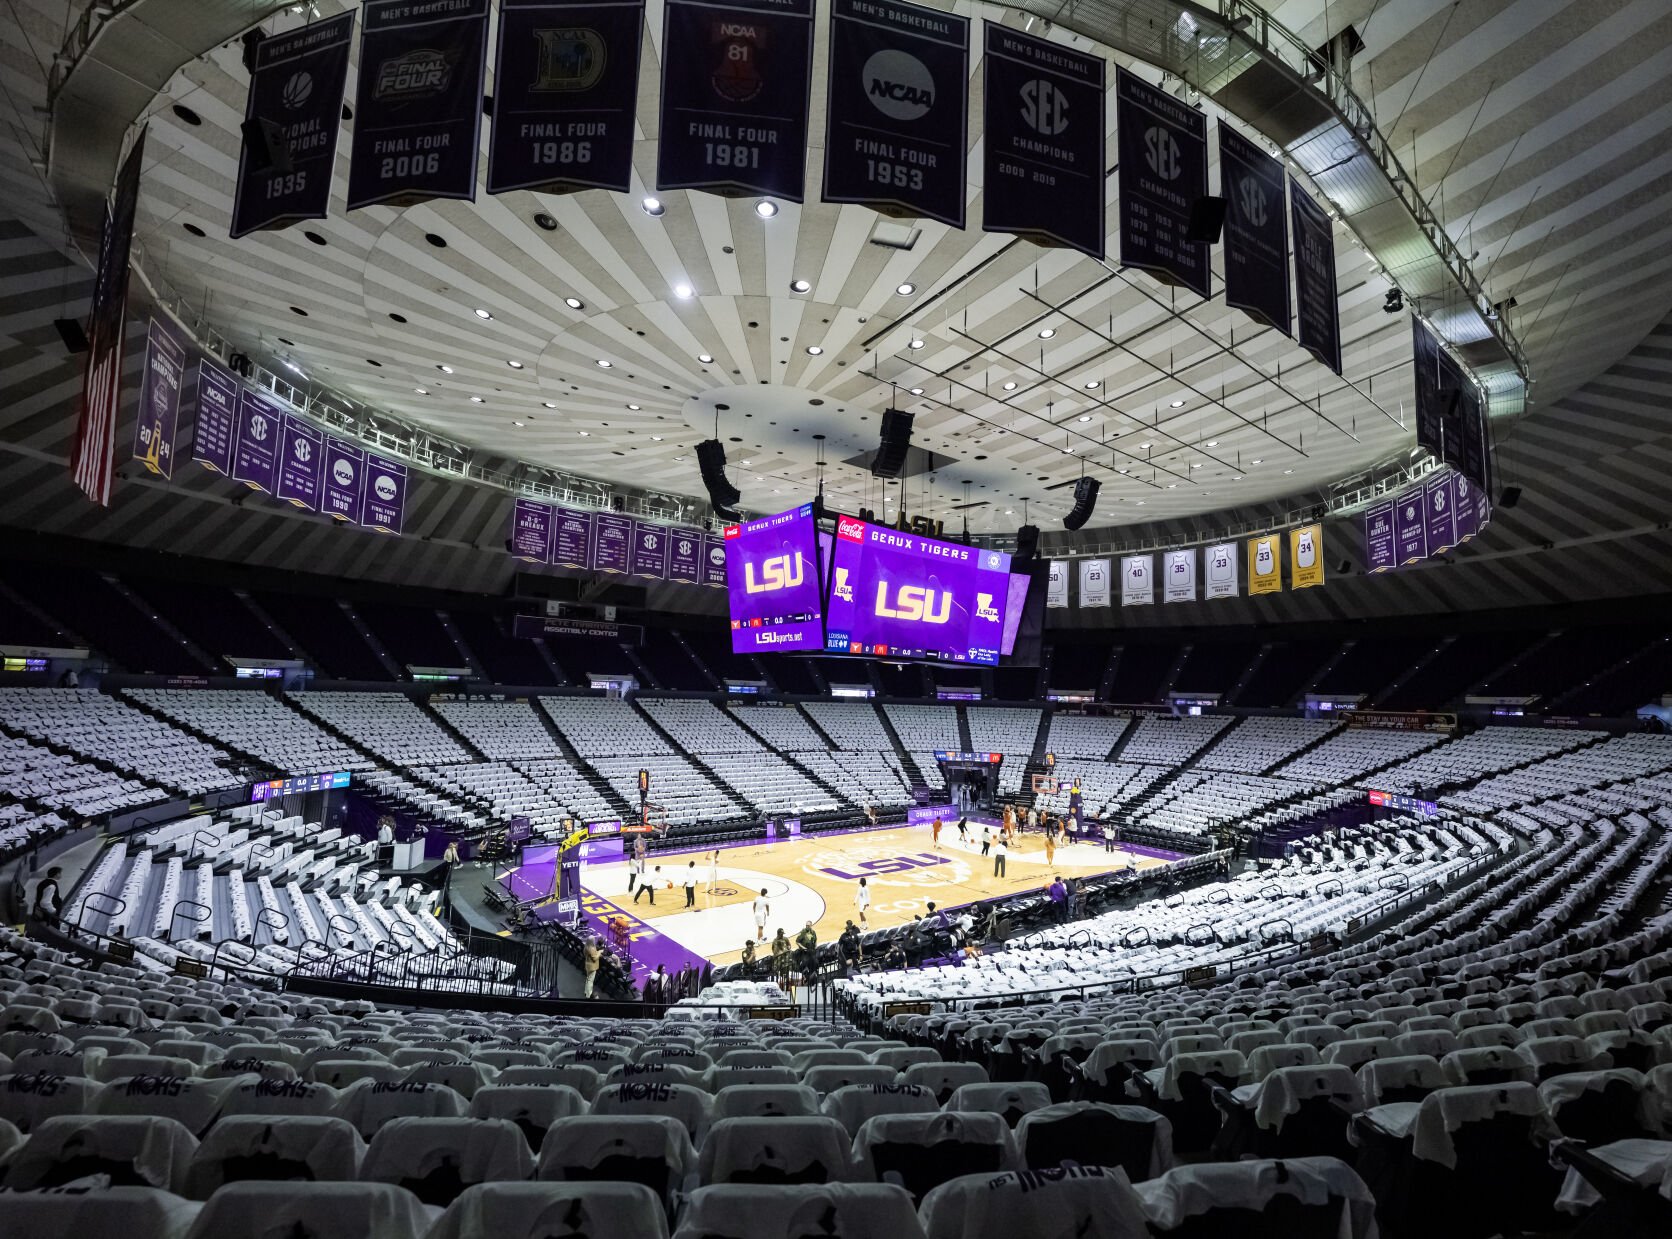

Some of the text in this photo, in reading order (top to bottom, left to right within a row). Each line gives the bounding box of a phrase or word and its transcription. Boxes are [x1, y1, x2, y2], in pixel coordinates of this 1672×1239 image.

[380, 0, 471, 20] MEN'S BASKETBALL
[852, 2, 950, 34] MEN'S BASKETBALL
[720, 23, 757, 39] NCAA
[728, 44, 748, 62] 81
[1003, 38, 1089, 75] MEN'S BASKETBALL
[398, 60, 444, 76] FINAL
[380, 71, 443, 93] FOUR
[869, 78, 932, 108] NCAA
[1019, 79, 1070, 136] SEC
[520, 122, 607, 138] FINAL FOUR
[689, 122, 777, 144] FINAL FOUR
[374, 133, 451, 154] FINAL FOUR
[532, 141, 592, 164] 1986
[855, 138, 937, 168] FINAL FOUR
[1013, 136, 1075, 163] CHAMPIONS
[1144, 126, 1182, 181] SEC
[380, 152, 440, 179] 2006
[705, 143, 759, 169] 1981
[867, 160, 923, 191] 1953
[999, 163, 1056, 186] 2009 2019
[266, 171, 307, 199] 1935
[1140, 177, 1187, 208] CHAMPIONS
[1239, 175, 1267, 227] SEC
[207, 386, 226, 405] NCAA
[250, 415, 268, 441] SEC
[140, 424, 170, 459] 20 24
[294, 438, 311, 462] SEC
[336, 469, 353, 482] NCAA
[330, 490, 352, 503] FINAL FOUR
[377, 485, 396, 496] NCAA
[333, 498, 349, 511] 1990
[371, 505, 396, 517] FINAL FOUR
[375, 513, 391, 524] 1991
[520, 520, 545, 530] BREAUX
[748, 514, 793, 532] GEAUX TIGERS
[643, 534, 658, 550] SEC
[678, 540, 692, 556] SEC
[871, 531, 913, 549] GEAUX
[920, 542, 969, 560] TIGERS
[1300, 543, 1311, 553] 34
[1216, 558, 1227, 568] 33
[1259, 552, 1270, 561] 33
[745, 551, 803, 594] LSU
[1089, 572, 1101, 580] 23
[1132, 568, 1142, 577] 40
[1174, 564, 1185, 573] 35
[836, 586, 848, 595] LSU
[875, 580, 952, 624] LSU
[978, 608, 993, 616] LSU
[543, 626, 588, 635] ASSEMBLY
[562, 861, 579, 869] YETI
[819, 853, 952, 880] LSU
